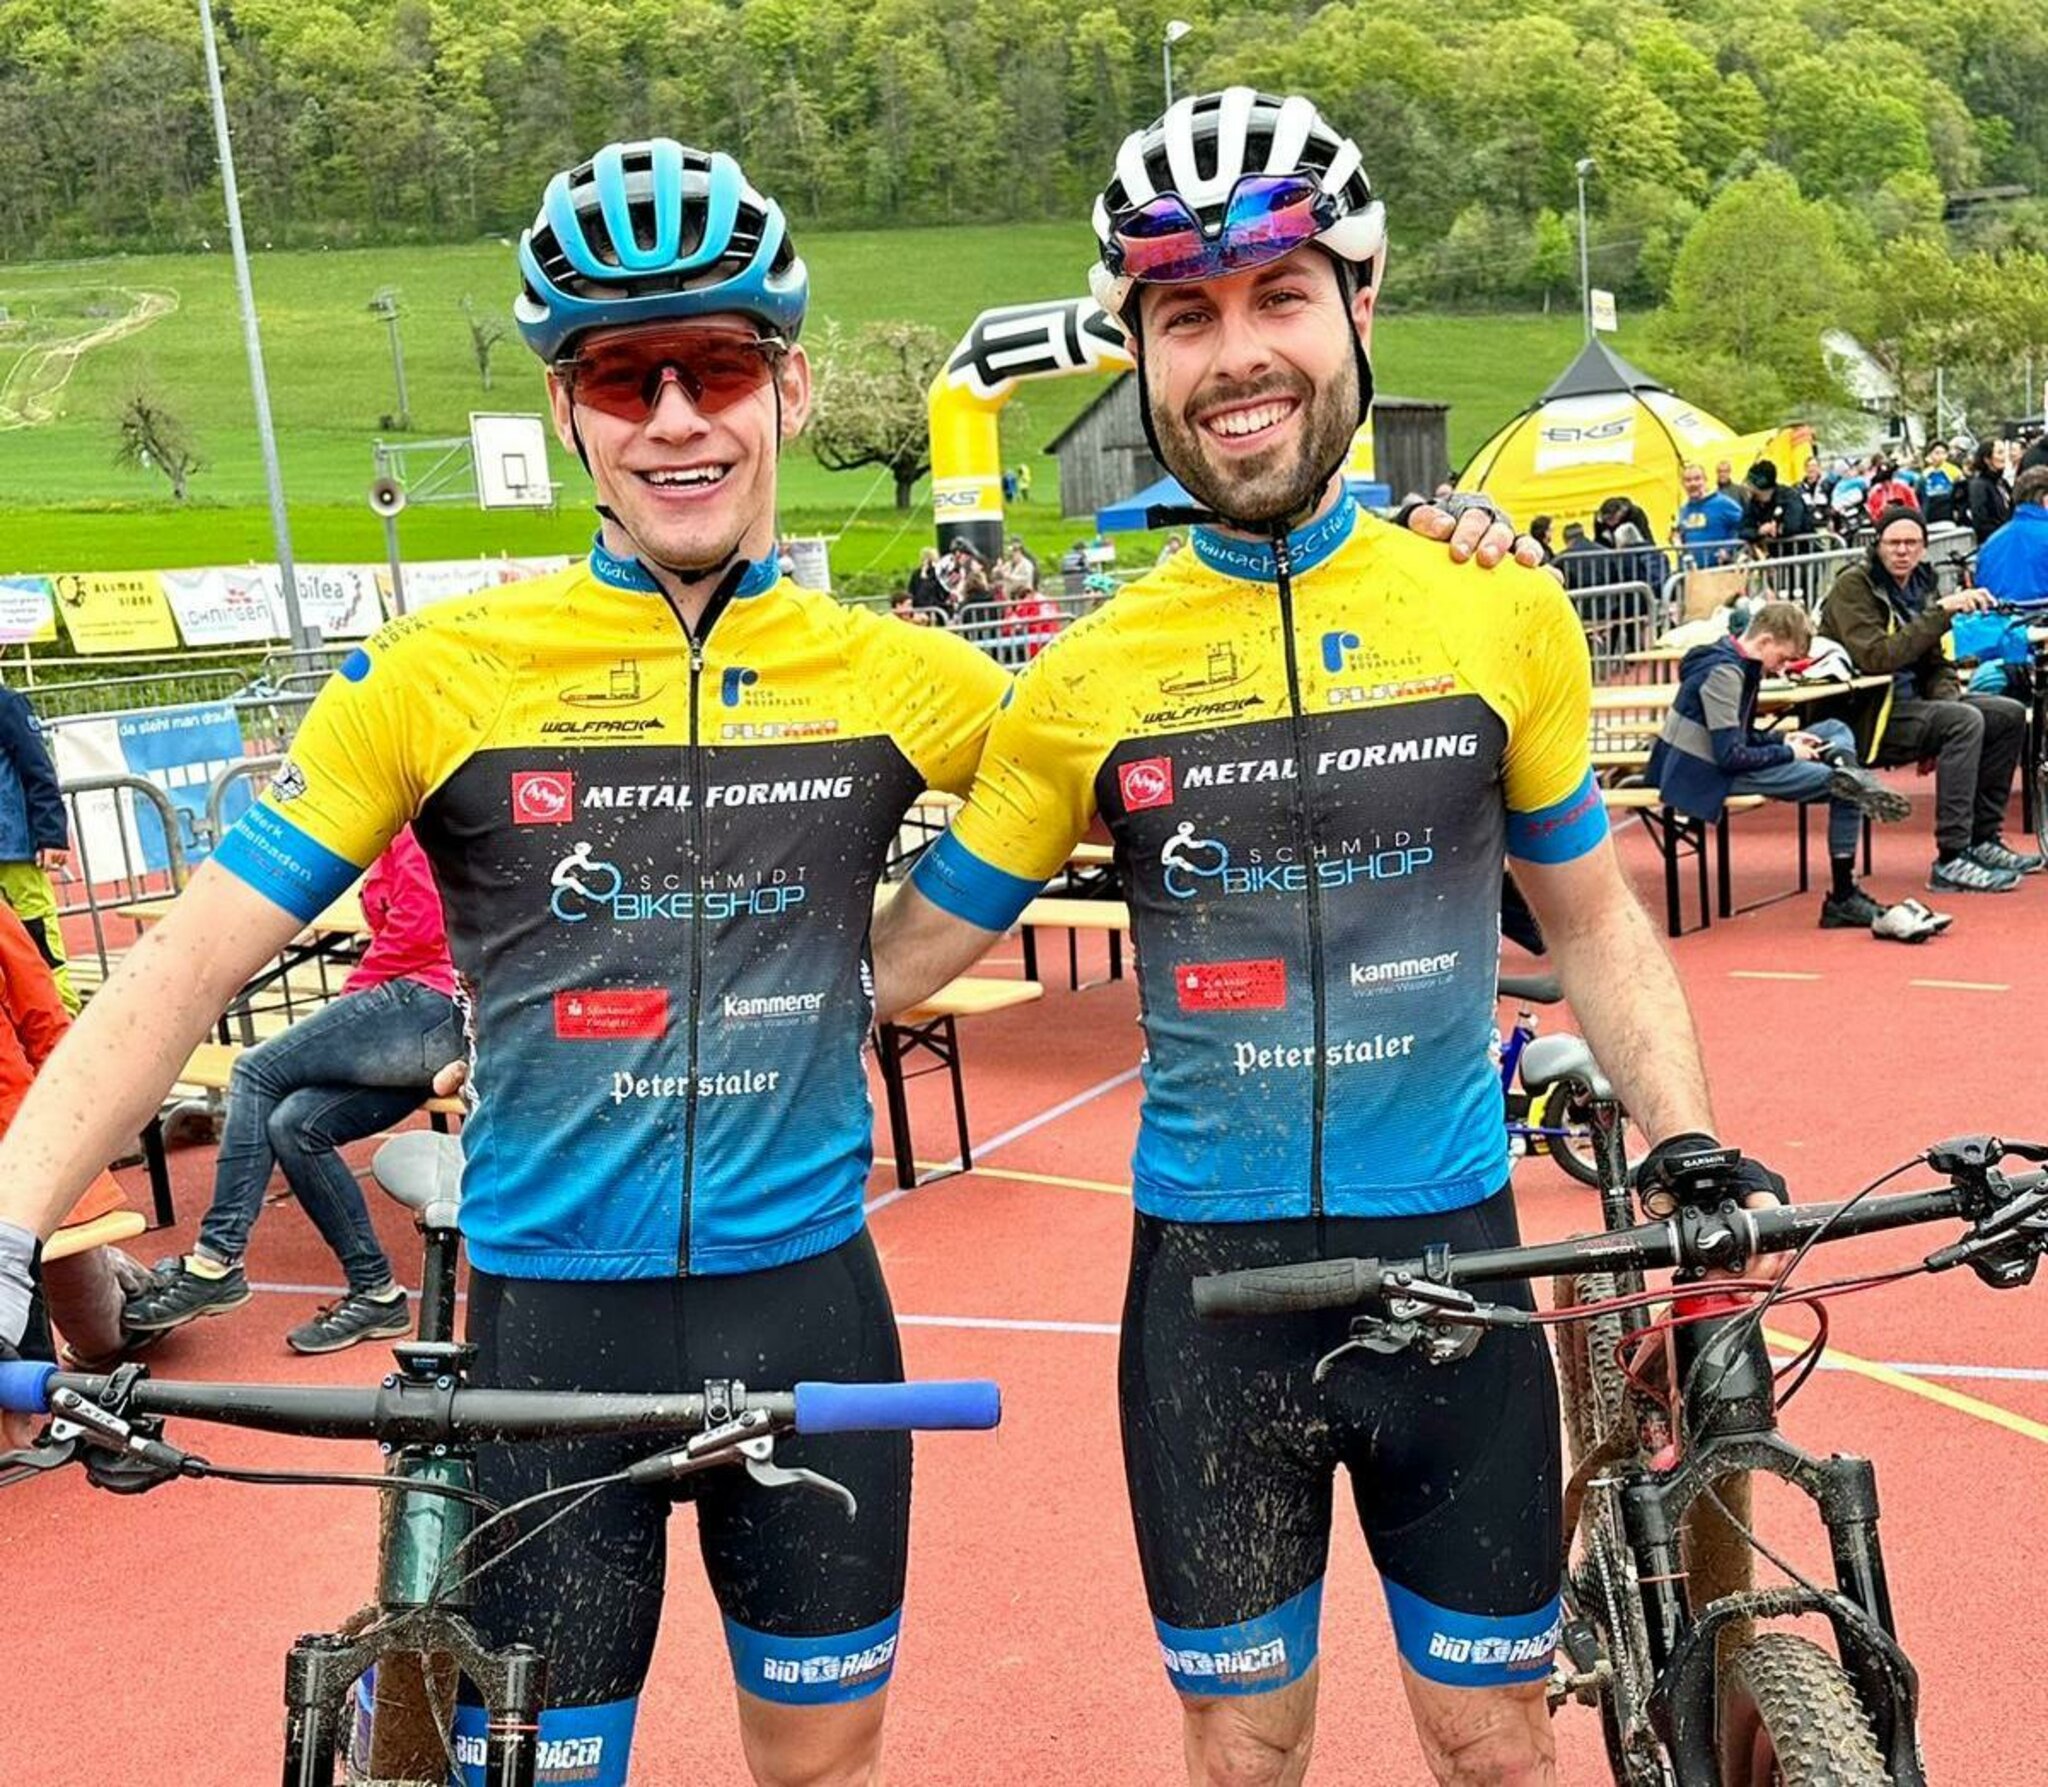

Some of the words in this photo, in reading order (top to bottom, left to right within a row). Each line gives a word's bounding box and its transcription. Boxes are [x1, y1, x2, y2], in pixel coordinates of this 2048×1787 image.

[540, 719, 646, 733] WOLFPACK
[1182, 757, 1299, 790] METAL
[1316, 733, 1479, 776] FORMING
[582, 784, 694, 808] METAL
[705, 776, 854, 807] FORMING
[1249, 827, 1434, 864] SCHMIDT
[639, 866, 806, 891] SCHMIDT
[1349, 950, 1460, 988] kammerer
[724, 992, 826, 1017] kammerer
[1682, 1154, 1726, 1169] GARMIN
